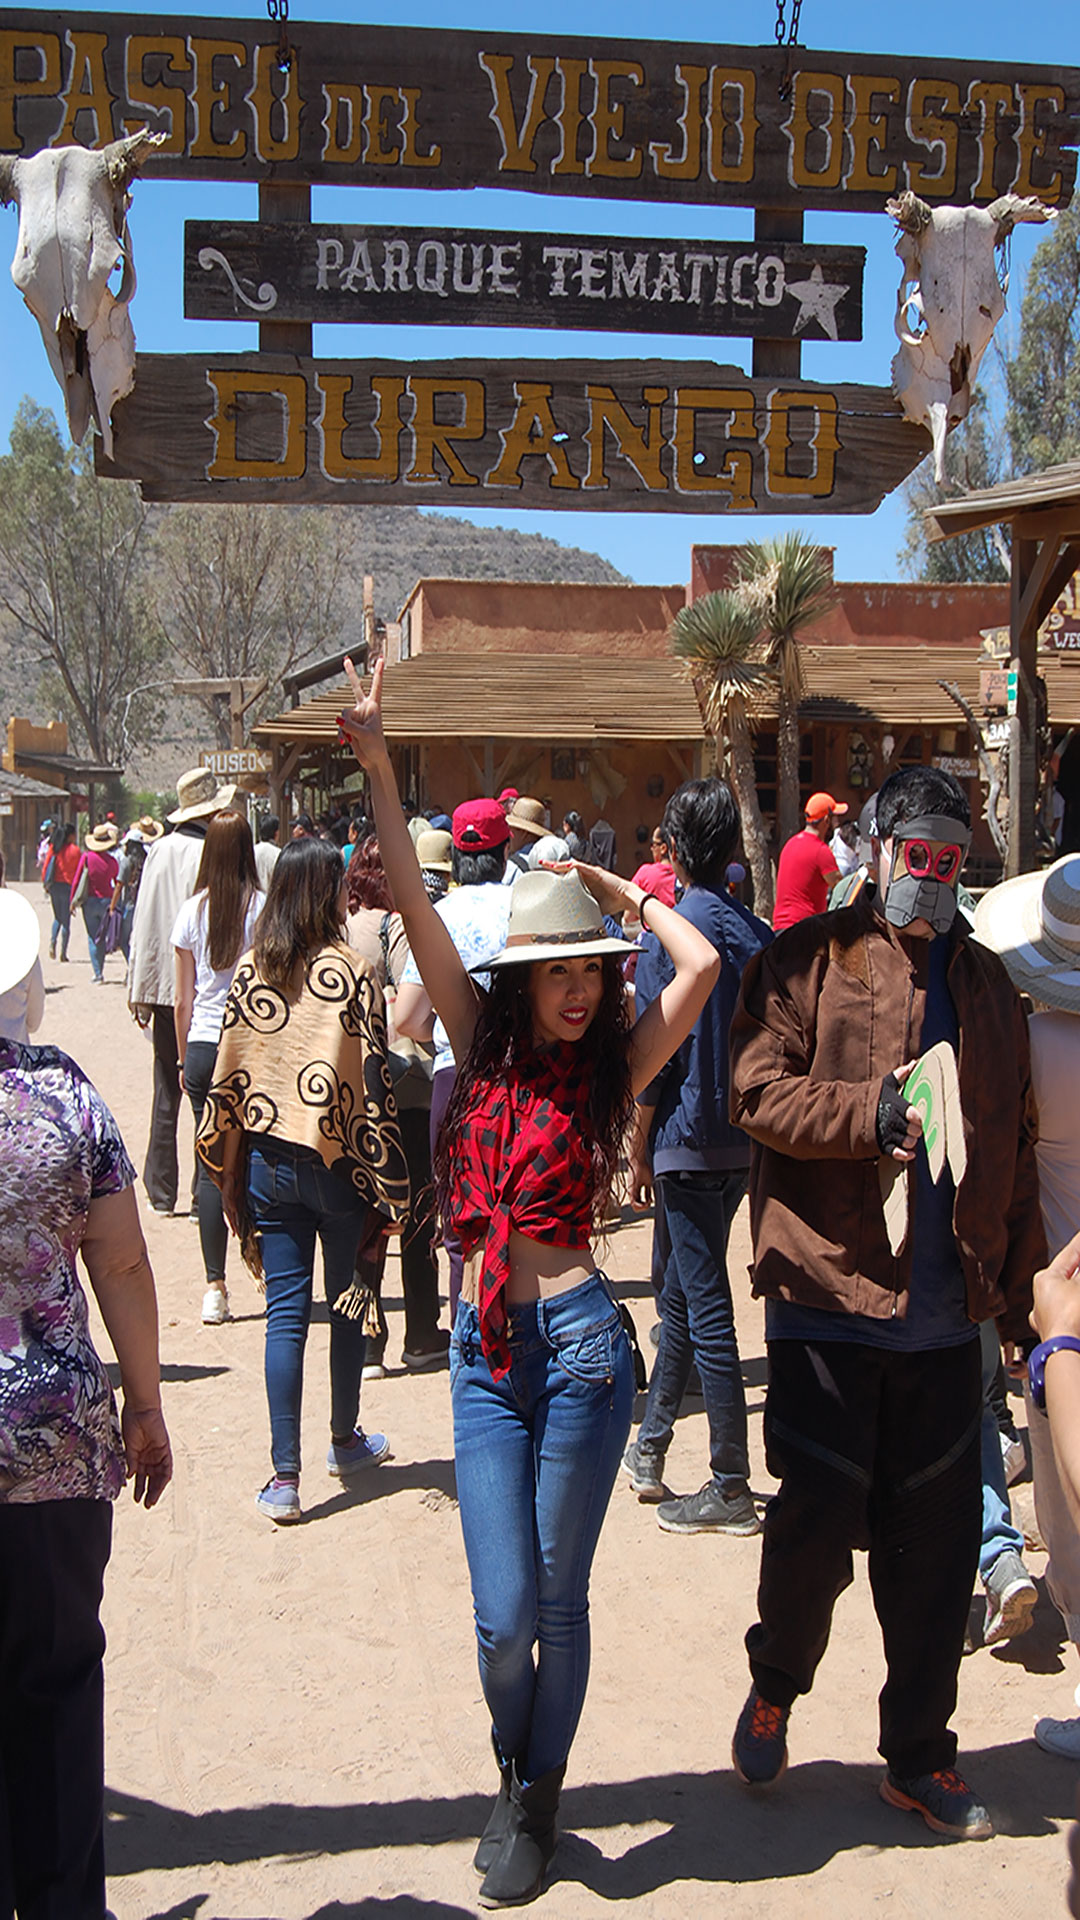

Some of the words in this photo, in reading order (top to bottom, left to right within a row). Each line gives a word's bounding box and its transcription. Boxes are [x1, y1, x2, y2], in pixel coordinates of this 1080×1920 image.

[0, 29, 306, 163] PASEO
[321, 83, 442, 167] DEL
[478, 51, 762, 184] VIEJO
[780, 70, 1066, 205] OESTE
[315, 238, 522, 298] PARQUE
[543, 246, 787, 309] TEMATICO
[205, 369, 844, 511] DURANGO
[203, 752, 257, 775] MUSEO
